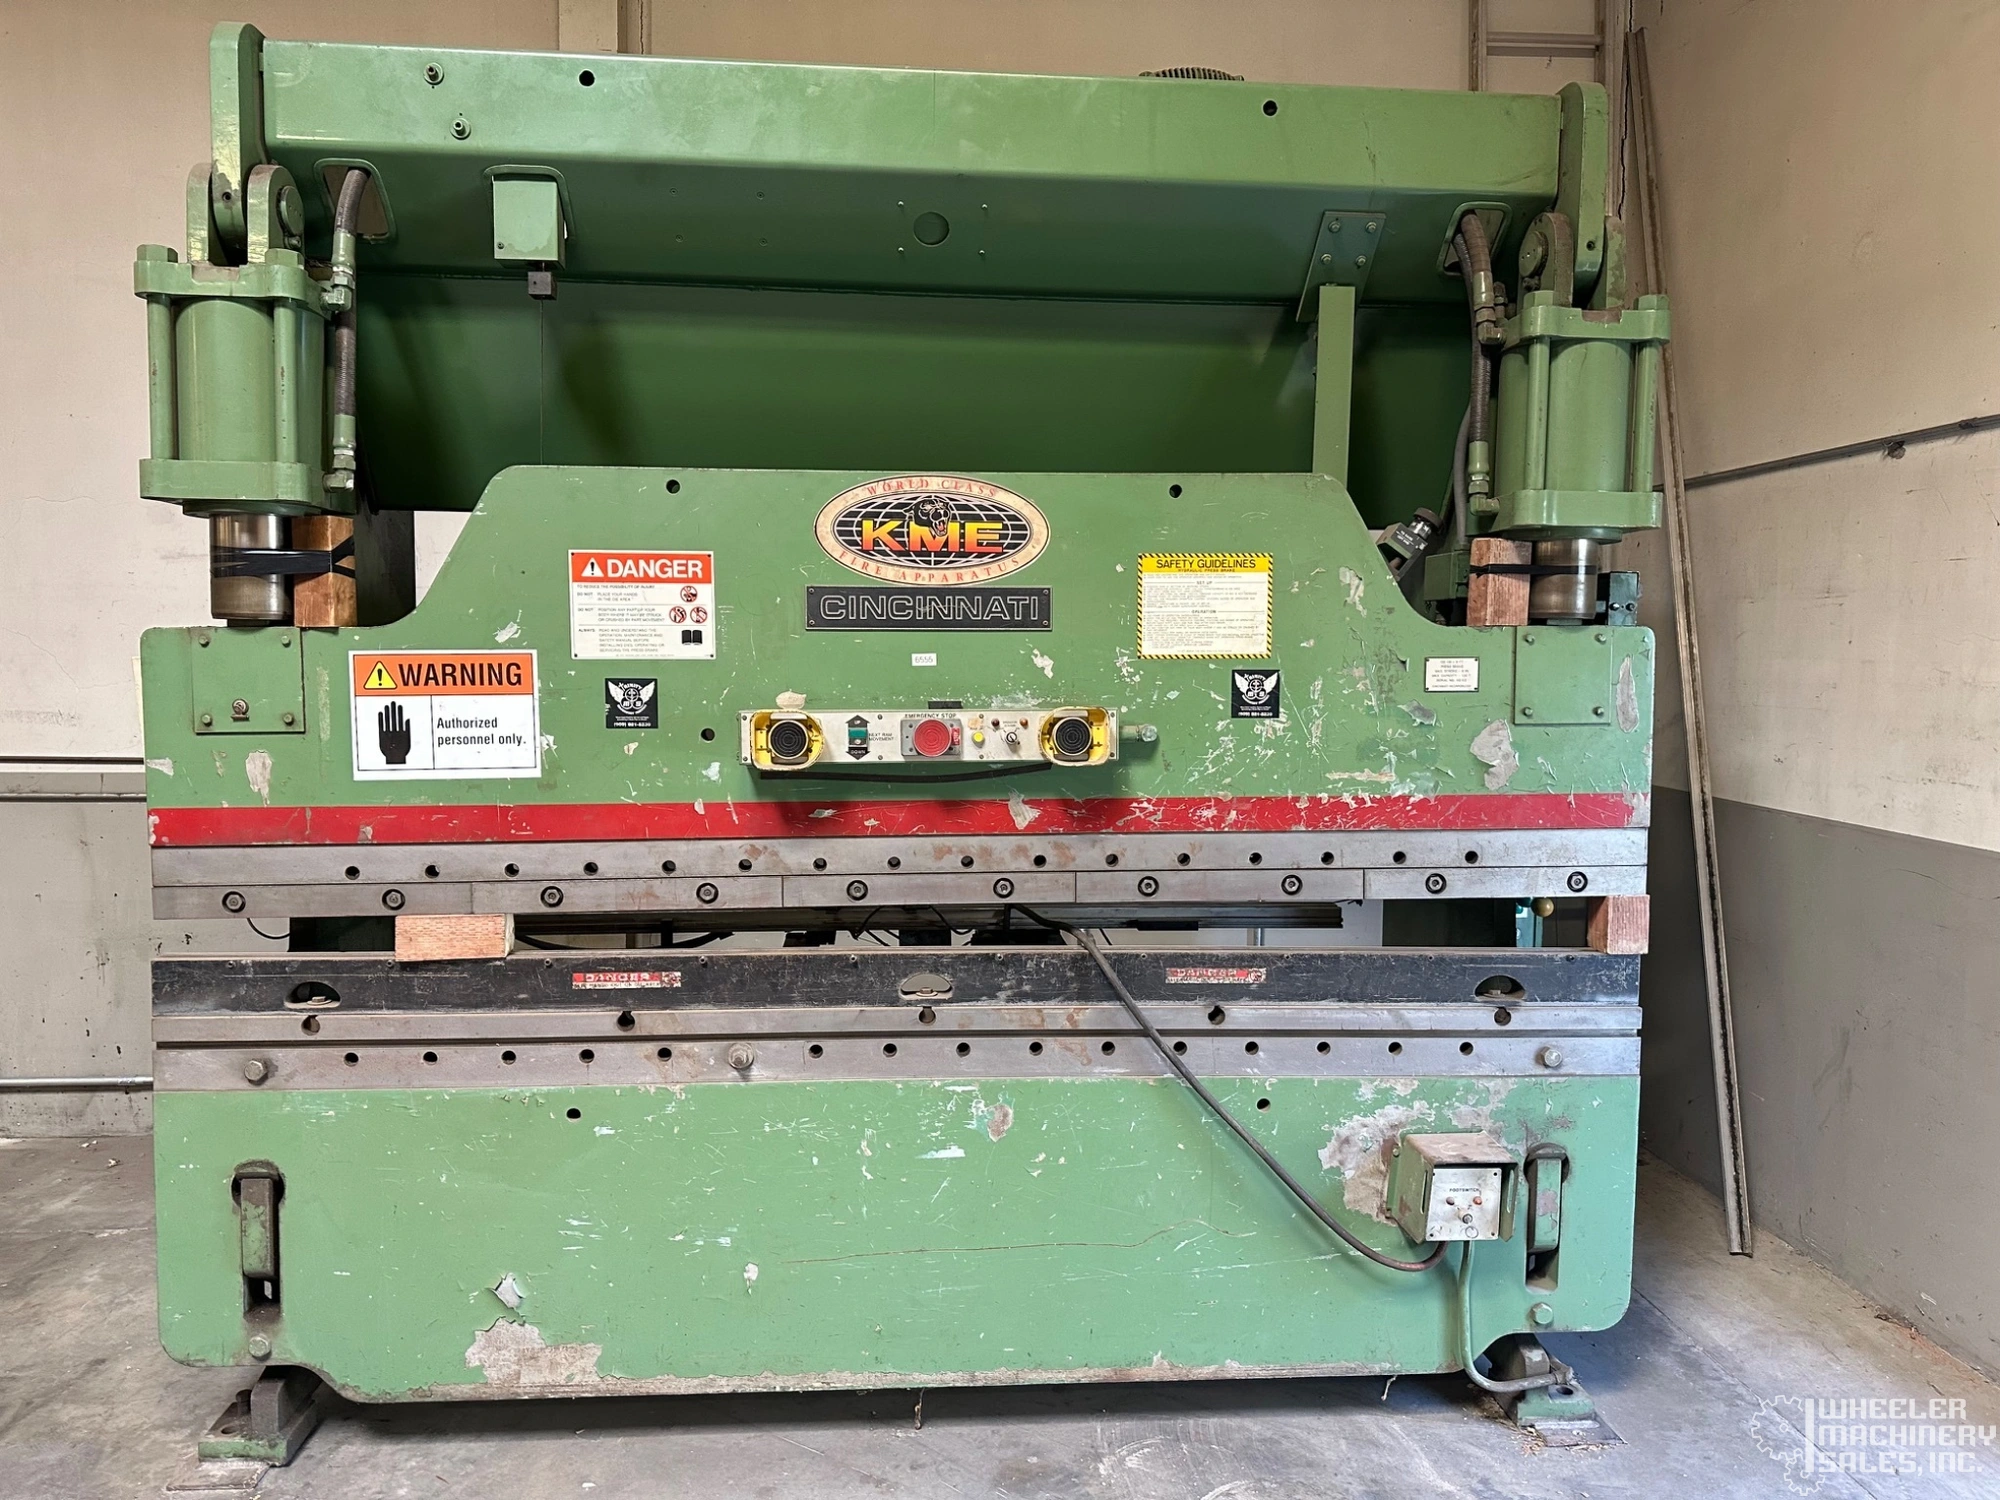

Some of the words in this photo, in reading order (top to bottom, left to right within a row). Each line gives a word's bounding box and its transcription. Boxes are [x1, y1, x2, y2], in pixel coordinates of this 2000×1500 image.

[867, 478, 929, 497] WORLD
[941, 479, 997, 498] CLASS
[861, 519, 1004, 553] KME
[607, 558, 703, 578] DANGER
[839, 552, 883, 575] FIRE
[899, 557, 1021, 583] APPARATUS
[1156, 559, 1195, 569] SAFETY
[1197, 559, 1256, 569] GUIDELINES
[820, 595, 1039, 621] CINCINNATI
[398, 662, 522, 687] WARNING
[437, 717, 498, 729] Authorized
[437, 733, 495, 748] personnel
[498, 733, 527, 747] only.
[585, 973, 650, 982] DANGER
